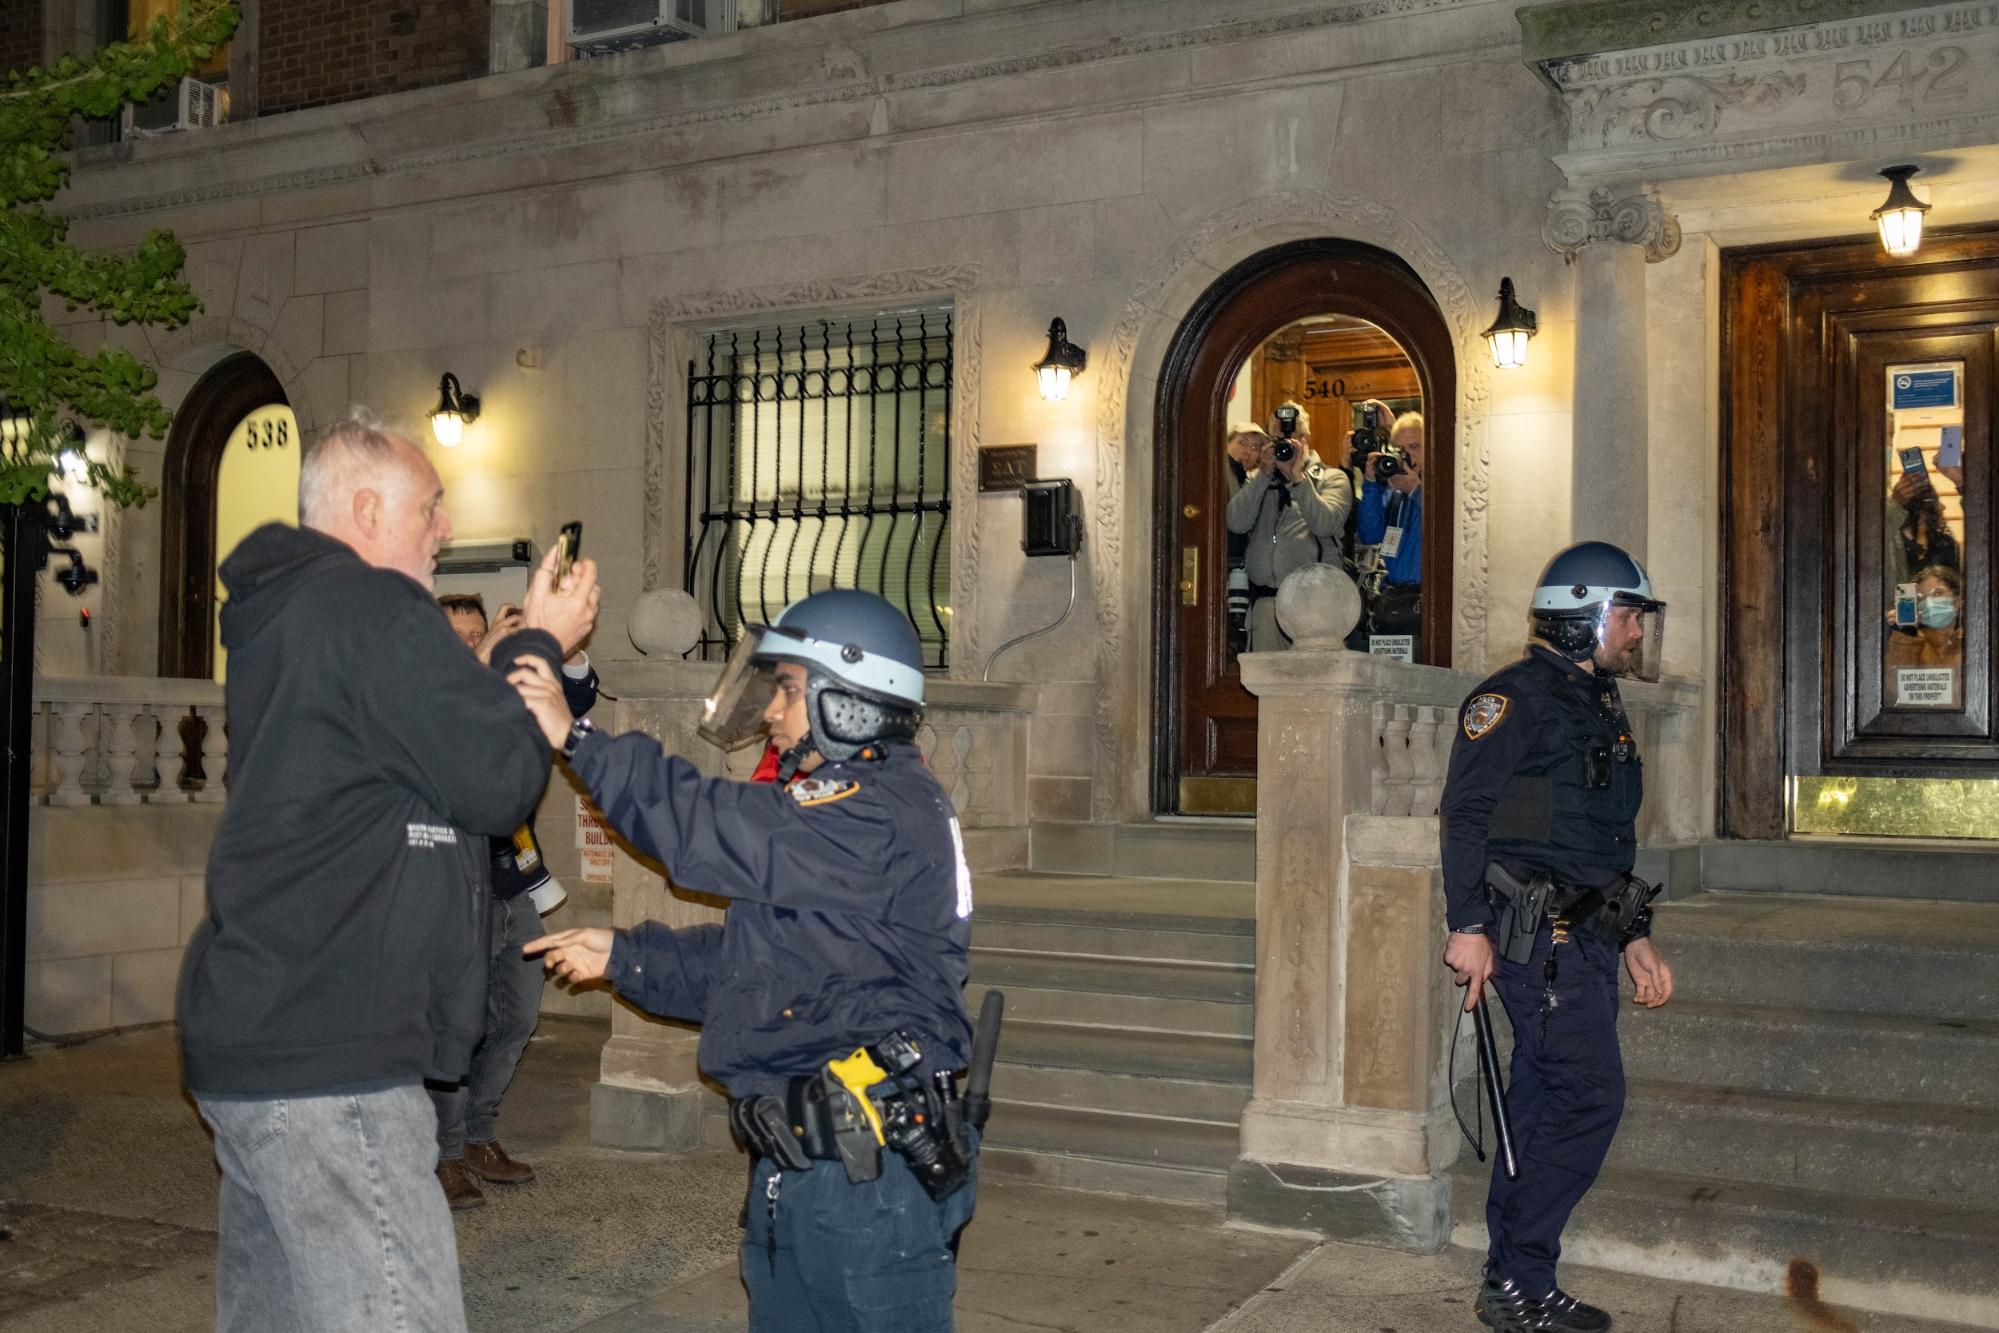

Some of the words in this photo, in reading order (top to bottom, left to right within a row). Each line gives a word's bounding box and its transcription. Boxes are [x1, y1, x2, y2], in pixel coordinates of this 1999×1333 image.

[1832, 46, 1968, 111] 542
[1304, 379, 1345, 399] 540
[247, 419, 288, 449] 538
[1904, 683, 1926, 691] ADVERTISING
[1914, 673, 1925, 681] PLACE
